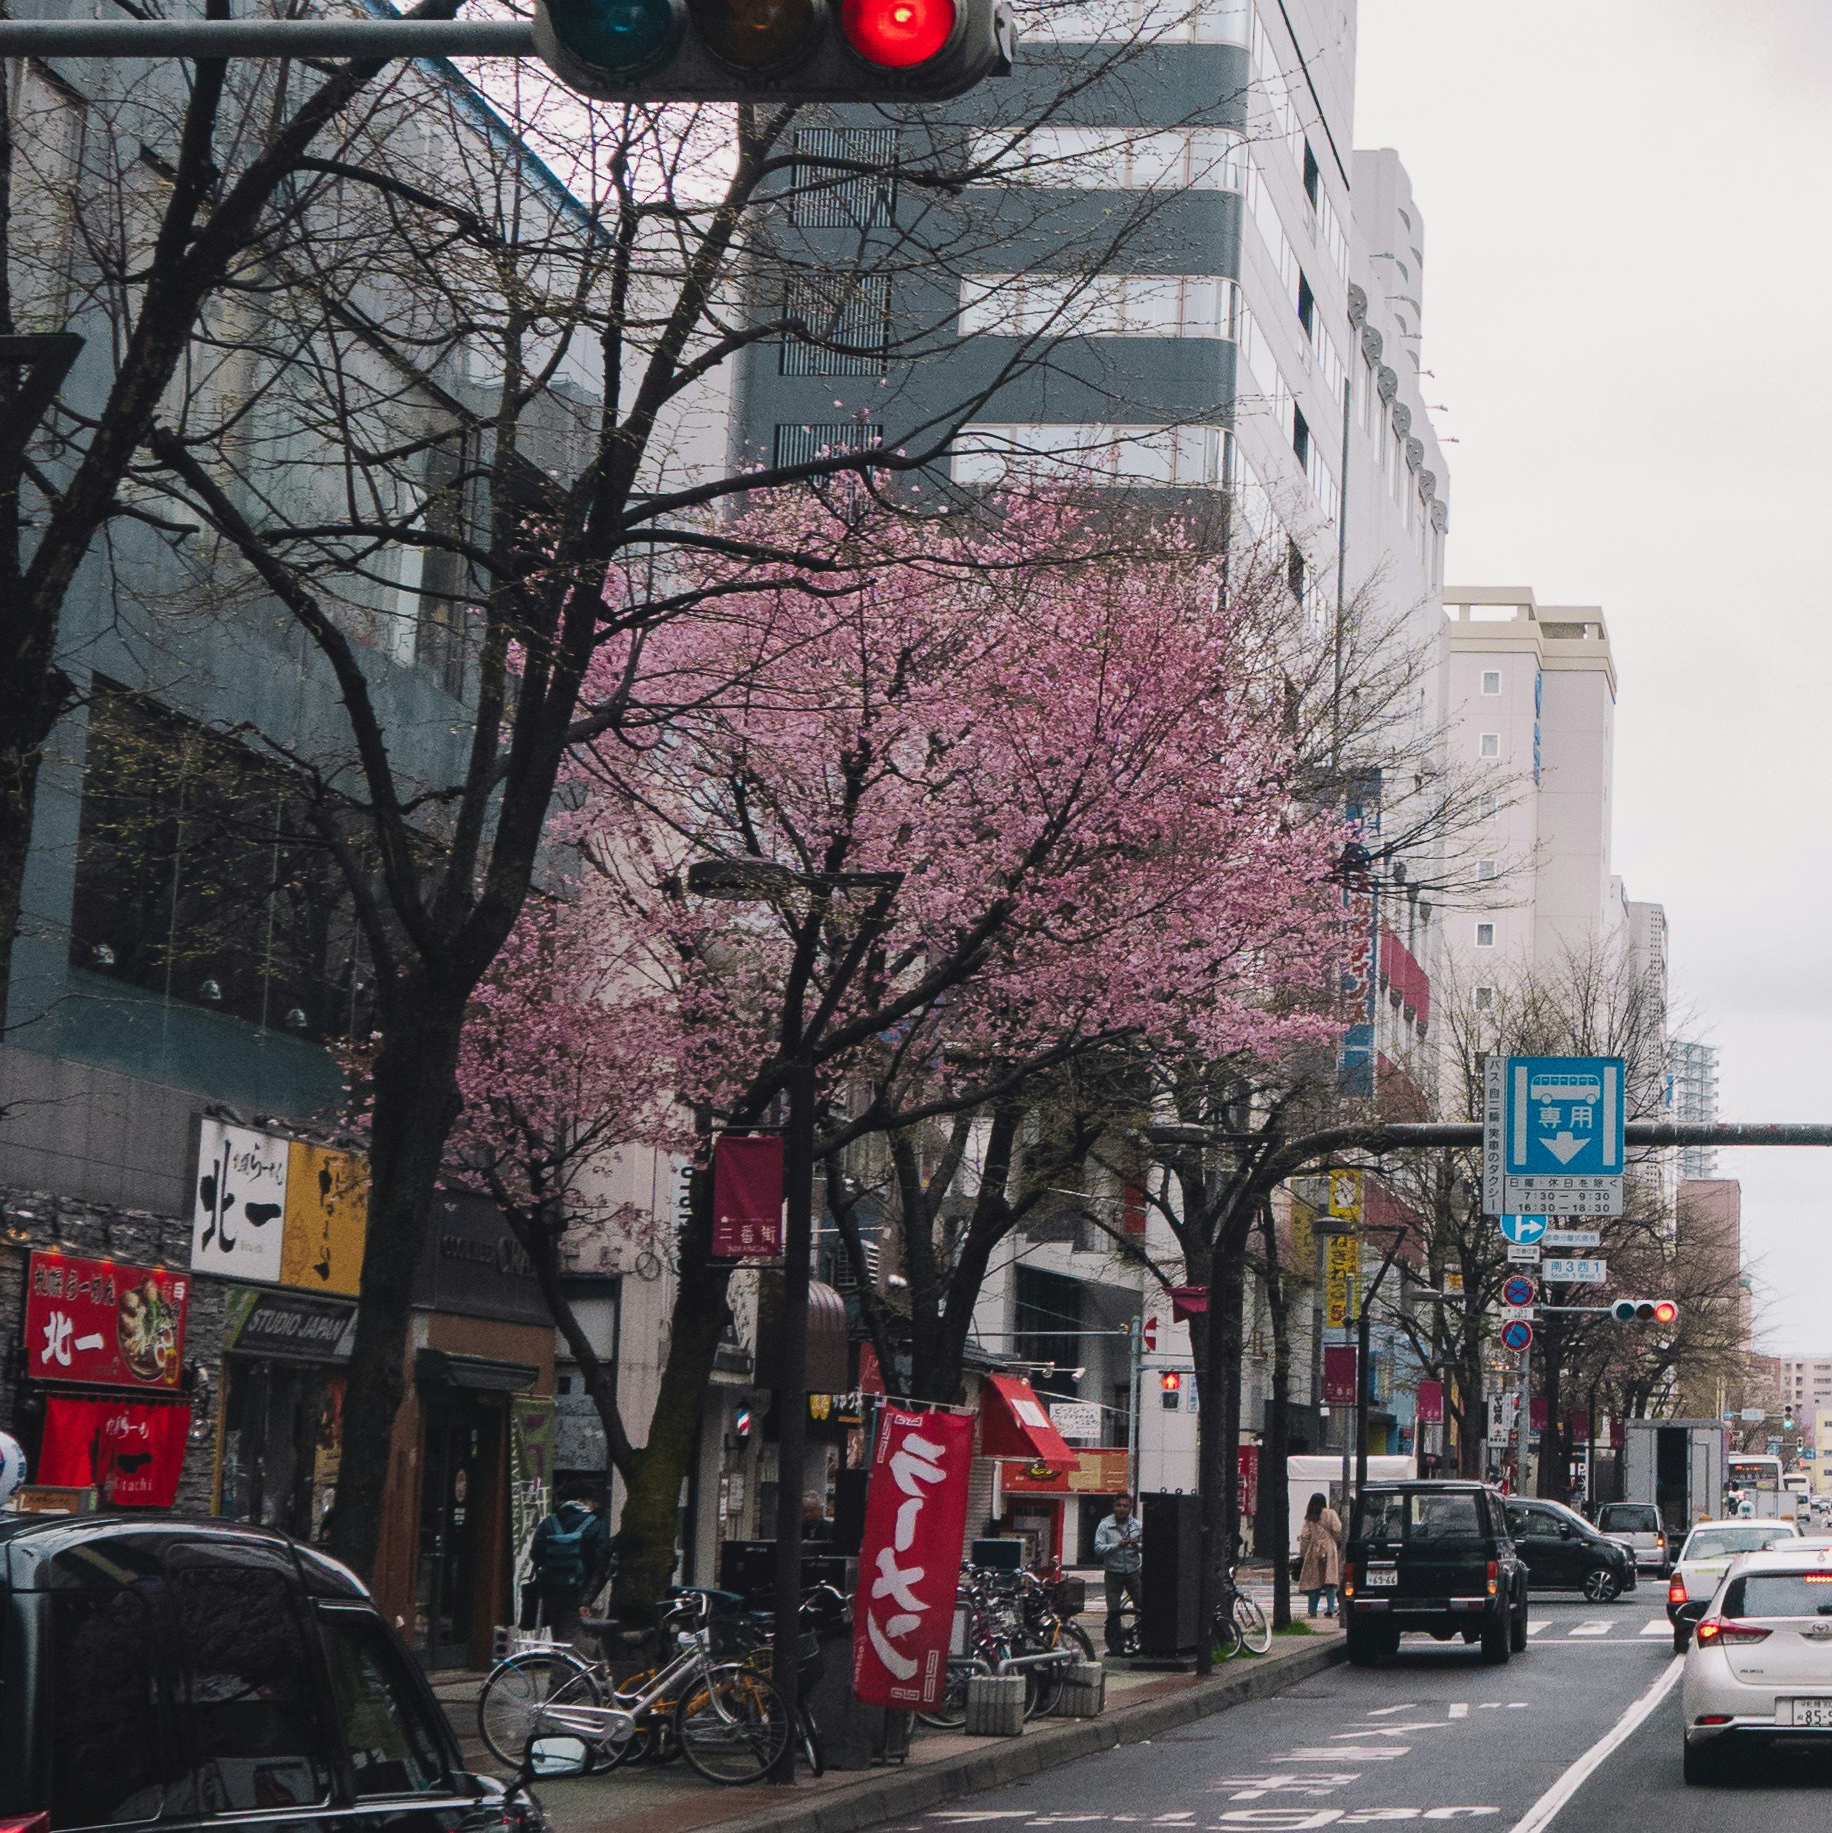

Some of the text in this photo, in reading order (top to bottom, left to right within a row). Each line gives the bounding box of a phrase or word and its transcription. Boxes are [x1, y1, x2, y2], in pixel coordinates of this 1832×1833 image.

[1538, 1106, 1593, 1129] 専用
[1524, 1191, 1555, 1201] 7:30
[1578, 1191, 1610, 1201] 9:30
[1518, 1203, 1555, 1213] 16:30
[1572, 1203, 1610, 1213] 18:30
[719, 1224, 776, 1244] 二番街
[250, 1309, 347, 1341] STUDIO JAPAN
[41, 1311, 104, 1366] 北一
[871, 1433, 947, 1681] ラーメン
